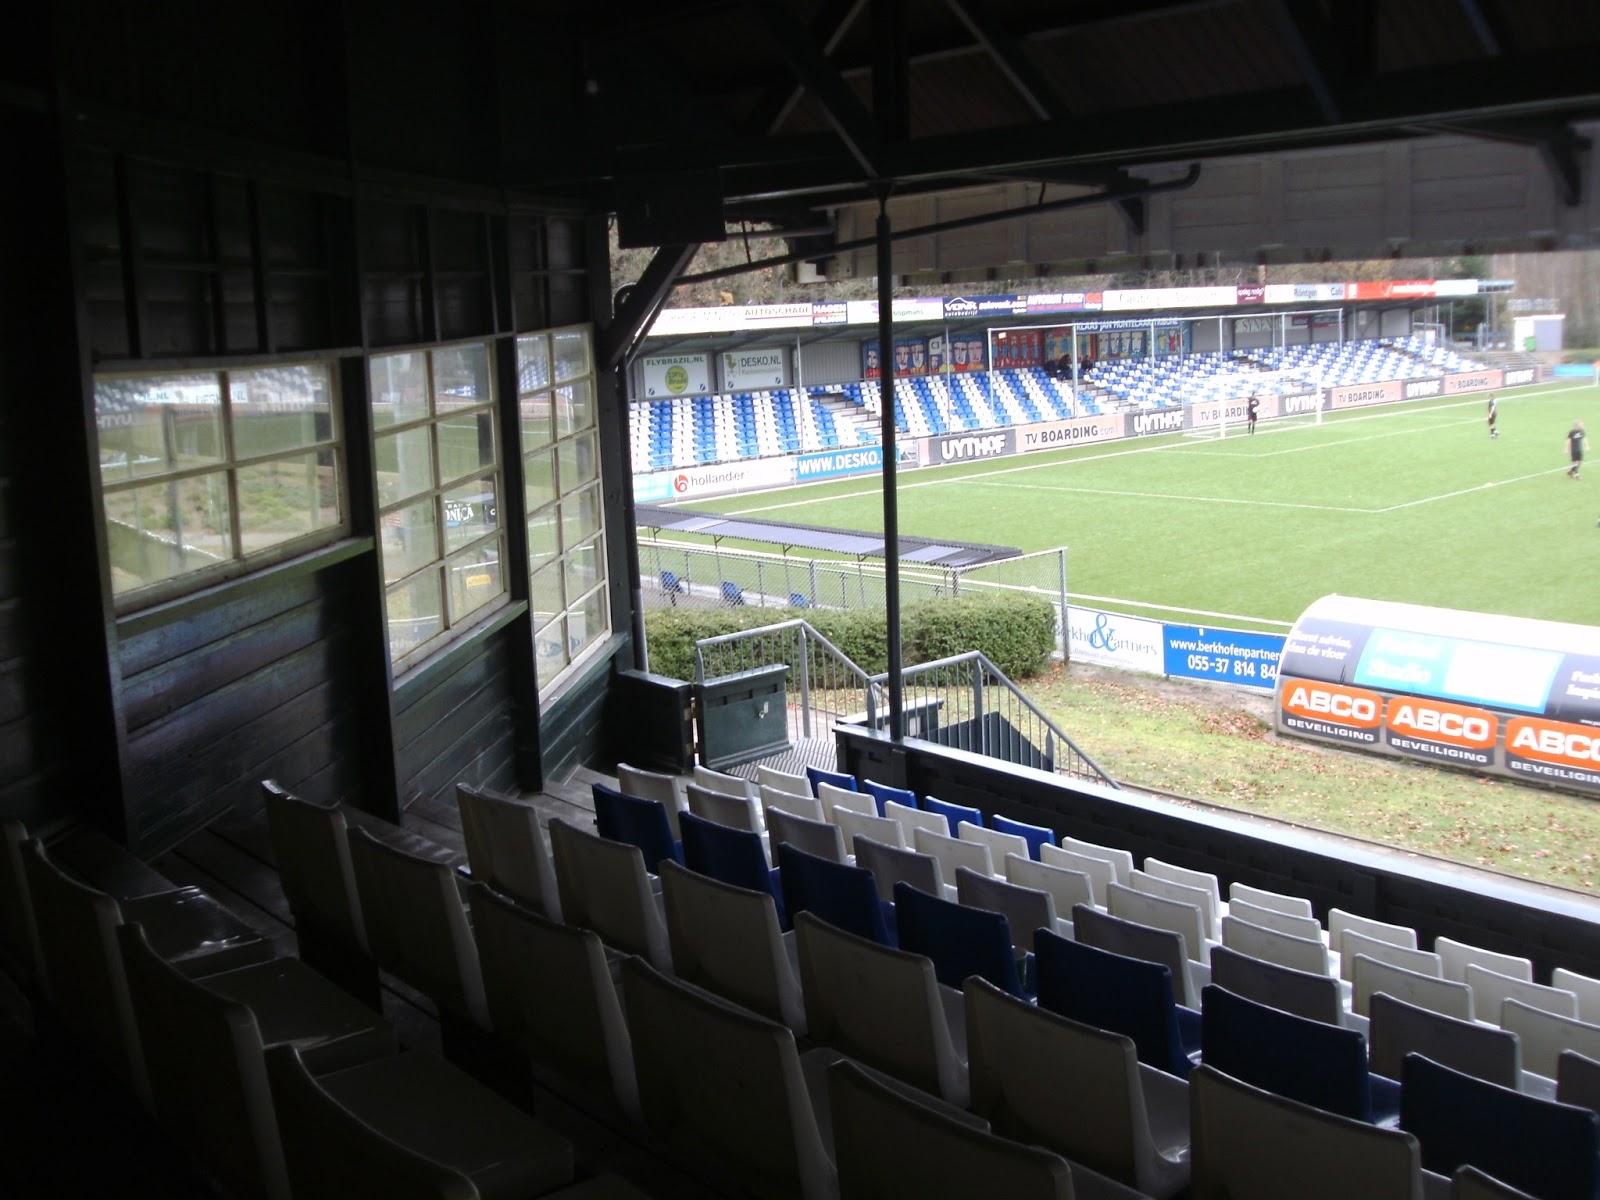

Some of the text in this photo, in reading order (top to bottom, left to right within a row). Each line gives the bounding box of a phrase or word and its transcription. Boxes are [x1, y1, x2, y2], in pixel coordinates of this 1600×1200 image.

[646, 355, 705, 367] FLYBRAZIL.NL
[741, 355, 782, 368] DESKO.NL
[1348, 389, 1385, 402] BOARDING
[1133, 410, 1184, 433] UYTHOF
[1200, 410, 1211, 421] TV
[941, 434, 1006, 460] UYTHOF
[1025, 432, 1038, 445] TV
[1041, 425, 1099, 443] BOARDING
[798, 450, 882, 475] WWW.DESKO.
[690, 471, 745, 487] hollander
[1089, 612, 1117, 652] &
[1187, 654, 1278, 680] 055-37 814 84
[1287, 687, 1376, 721] ABCO
[1287, 718, 1375, 742] BEVEILIGING
[1391, 705, 1490, 742] ABCO
[1391, 737, 1488, 763] BEVEILIGING
